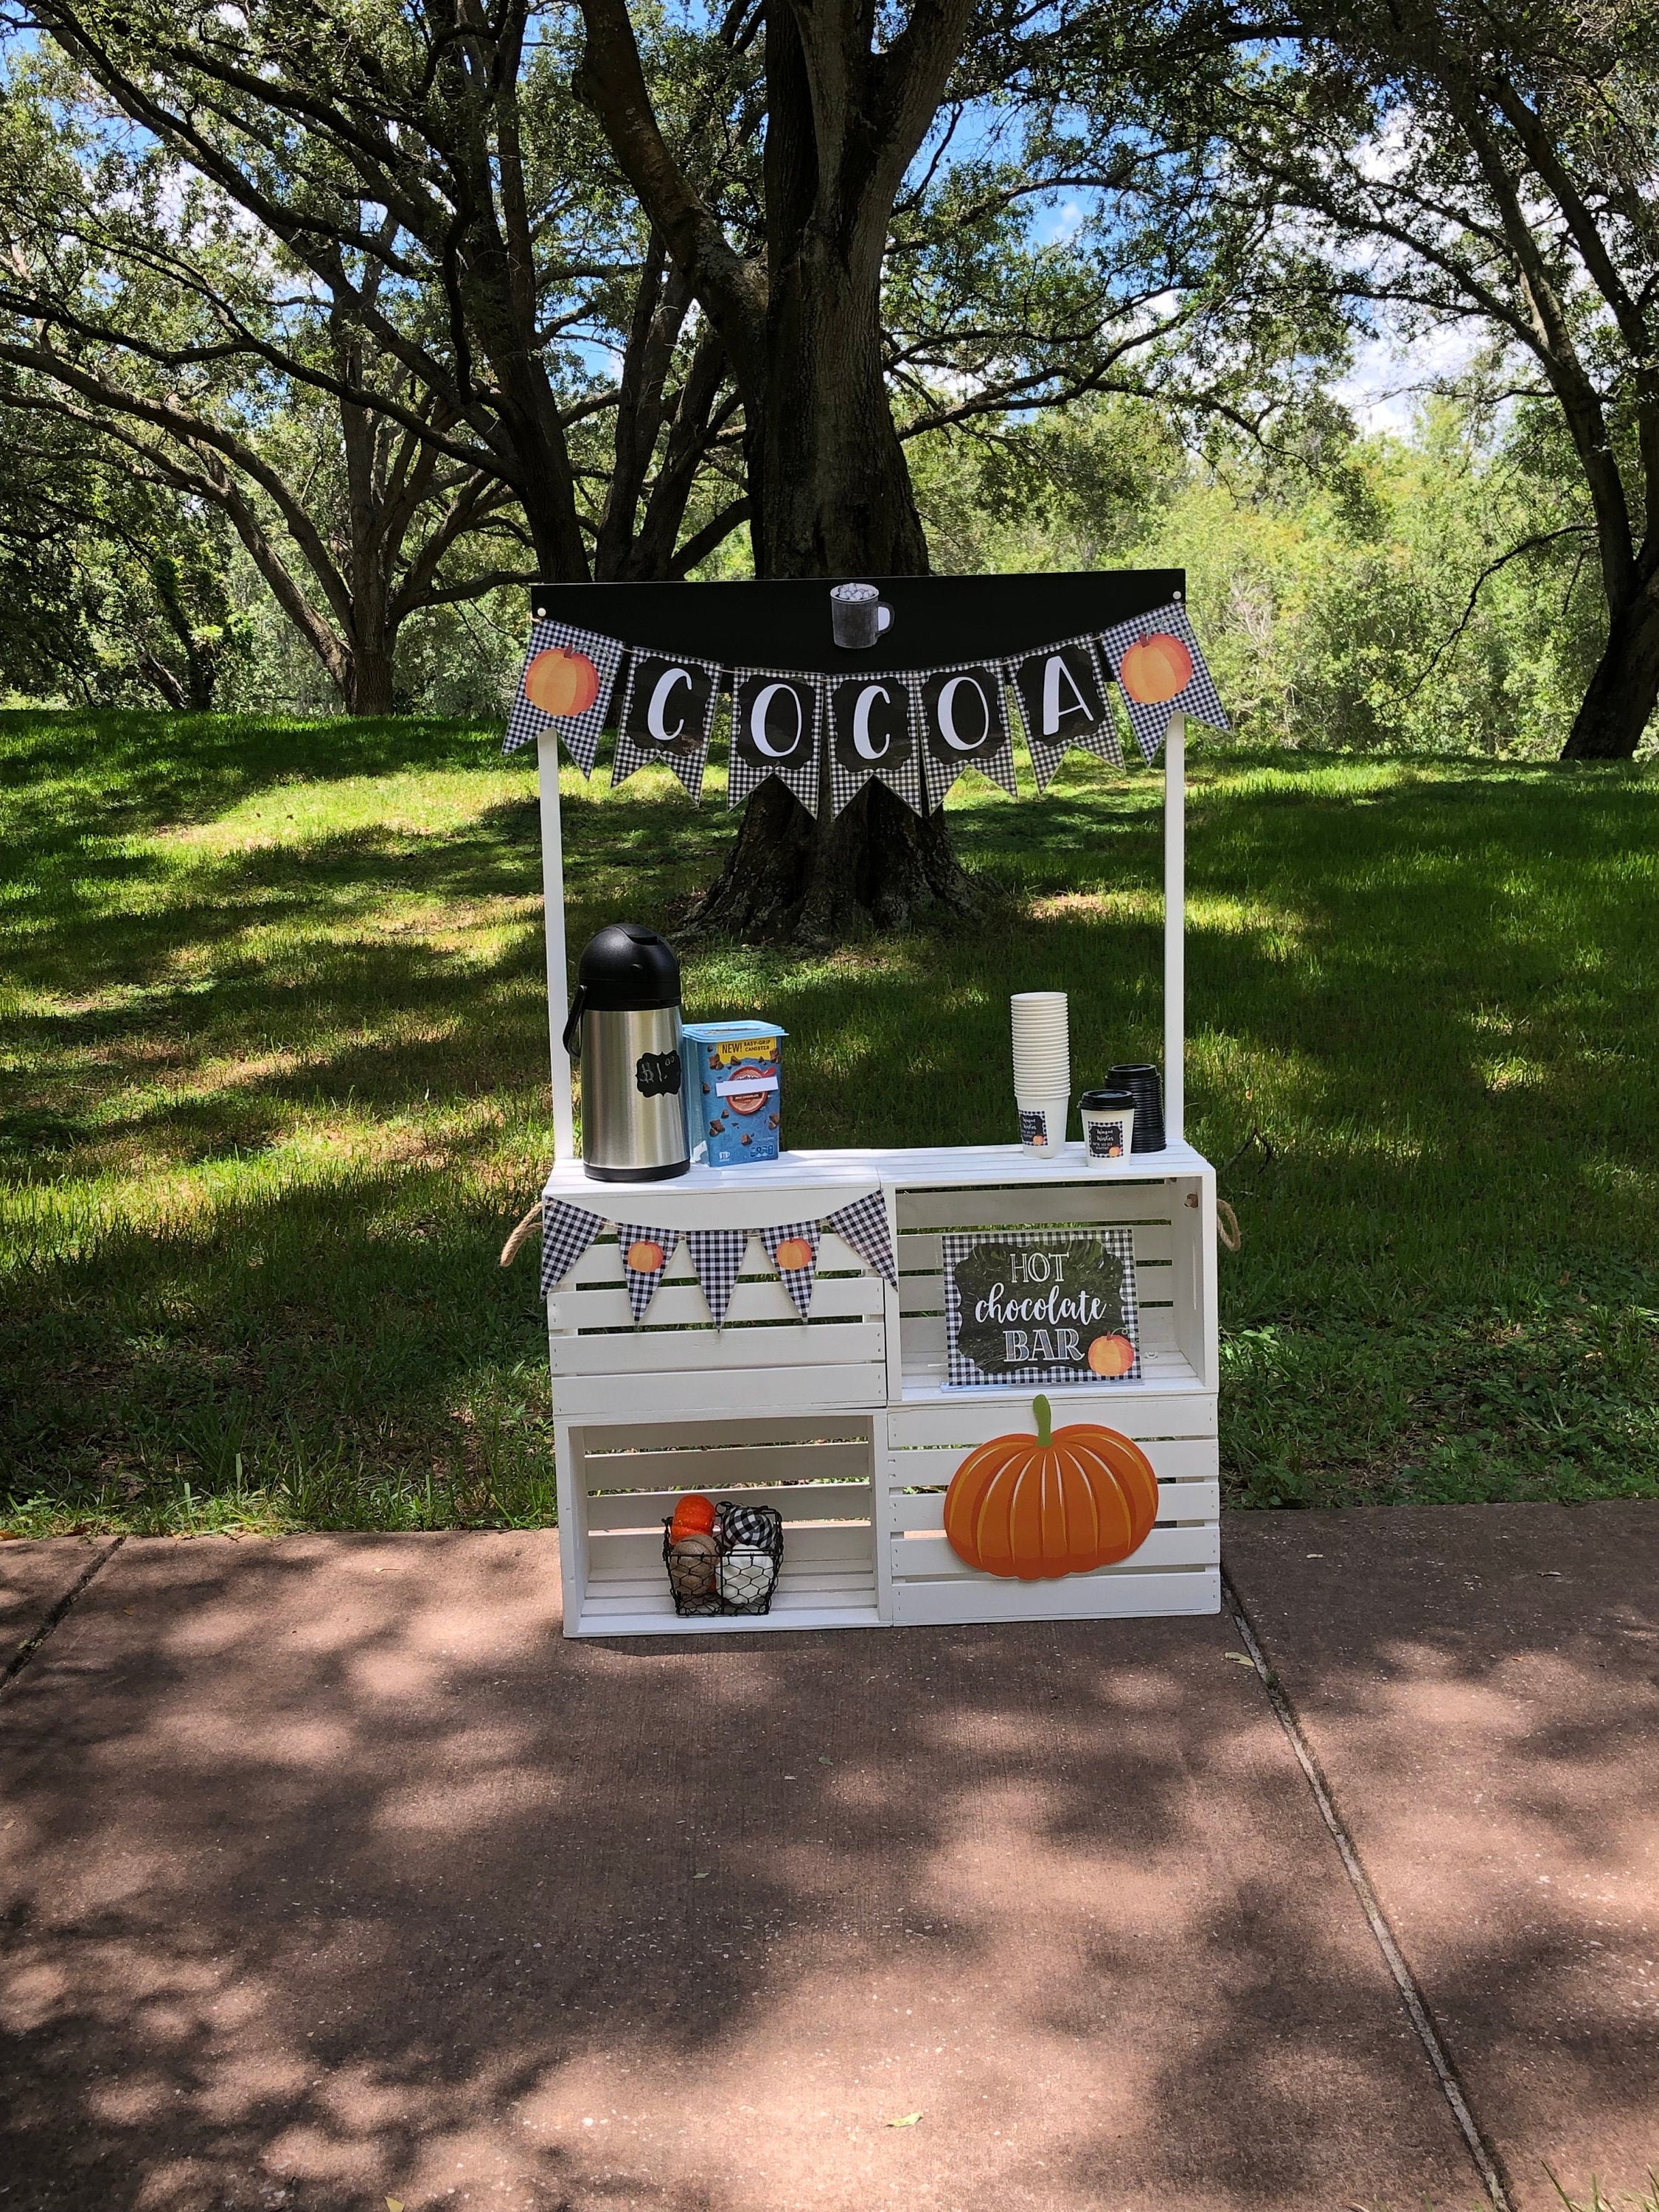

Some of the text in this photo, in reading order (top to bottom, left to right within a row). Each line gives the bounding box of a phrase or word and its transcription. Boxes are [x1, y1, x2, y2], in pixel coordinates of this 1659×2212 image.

[647, 653, 1095, 760] COCOA
[722, 1043, 742, 1054] NEW!
[1009, 1252, 1070, 1283] HOT
[975, 1282, 1107, 1326] chocolate
[1003, 1328, 1085, 1362] BAR
